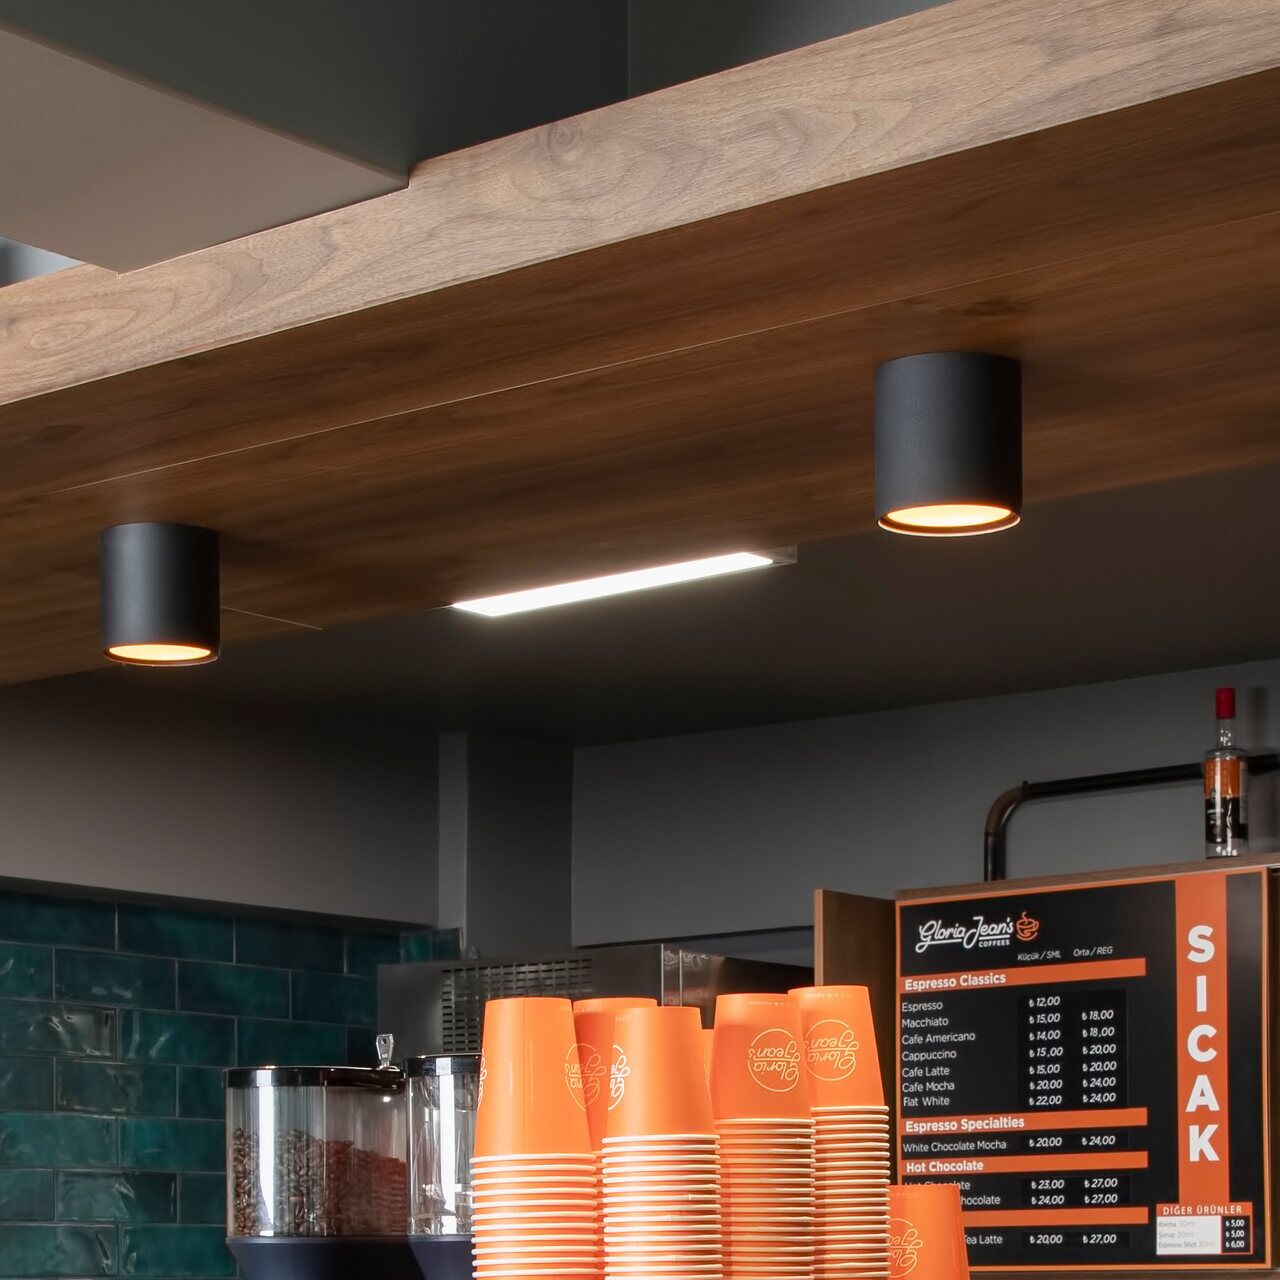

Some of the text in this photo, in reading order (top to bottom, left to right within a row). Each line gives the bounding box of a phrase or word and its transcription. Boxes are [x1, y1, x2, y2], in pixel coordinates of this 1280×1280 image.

[915, 916, 1013, 953] Gloria Jean's
[978, 939, 1010, 948] COFFEES
[1073, 946, 1113, 957] Orta REG
[904, 973, 1006, 991] Espresso Classics
[901, 1001, 943, 1012] Espresso
[902, 1017, 949, 1028] Macchiato
[902, 1032, 976, 1045] Cafe Americano
[1186, 924, 1221, 1162] SICAK
[902, 1049, 957, 1061] Cappuccino
[902, 1066, 950, 1077] Cafe Latte
[902, 1081, 955, 1093] Cafe Mocha
[903, 1096, 950, 1106] Flat White
[905, 1116, 1025, 1133] Espresso Specialties
[903, 1139, 1007, 1152] White Chocolate Mocha
[906, 1160, 984, 1173] Hot Chocolate
[1163, 1203, 1242, 1215] DİĞER ÜRÜNLER
[979, 1234, 1003, 1244] Latte
